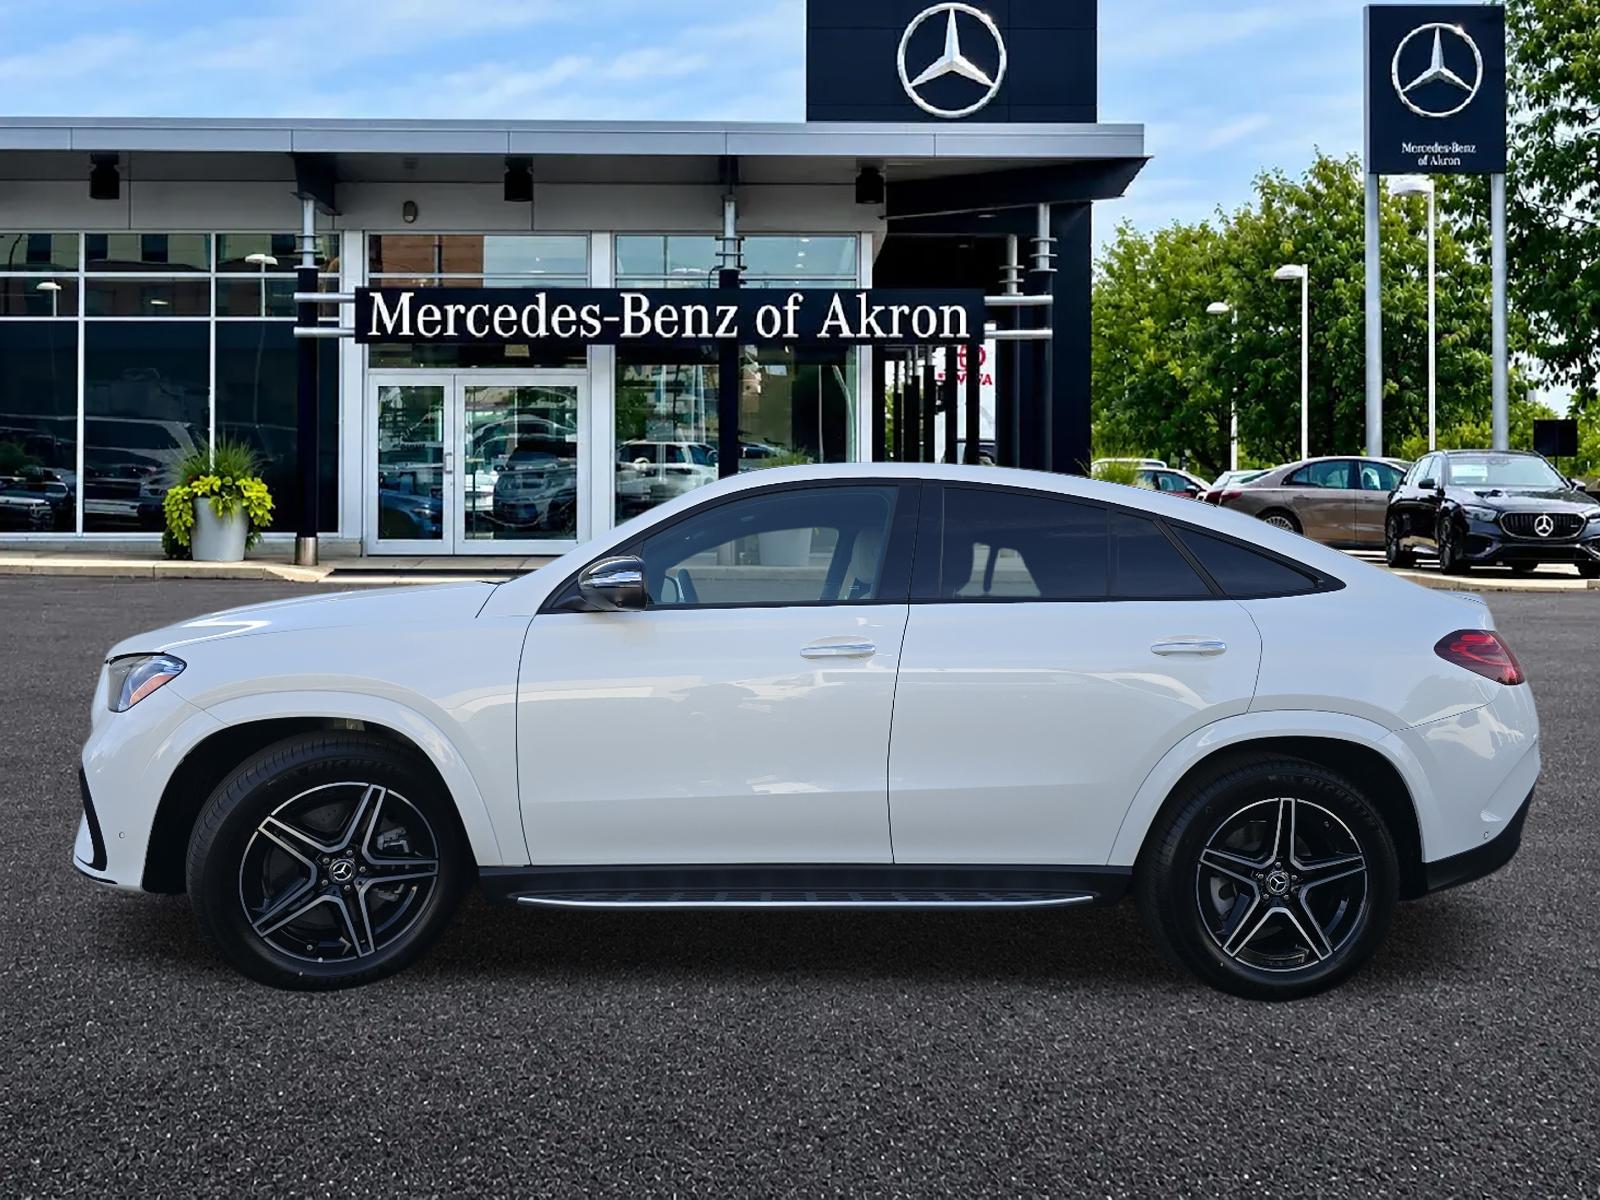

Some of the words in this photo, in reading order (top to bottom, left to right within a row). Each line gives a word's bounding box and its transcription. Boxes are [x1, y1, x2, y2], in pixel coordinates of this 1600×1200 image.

[1401, 141, 1476, 154] Mercedes-Benz
[1417, 154, 1428, 166] of
[1430, 154, 1461, 166] Akron
[367, 291, 738, 339] Mercedes-Benz
[755, 291, 803, 339] of
[816, 291, 971, 339] Akron
